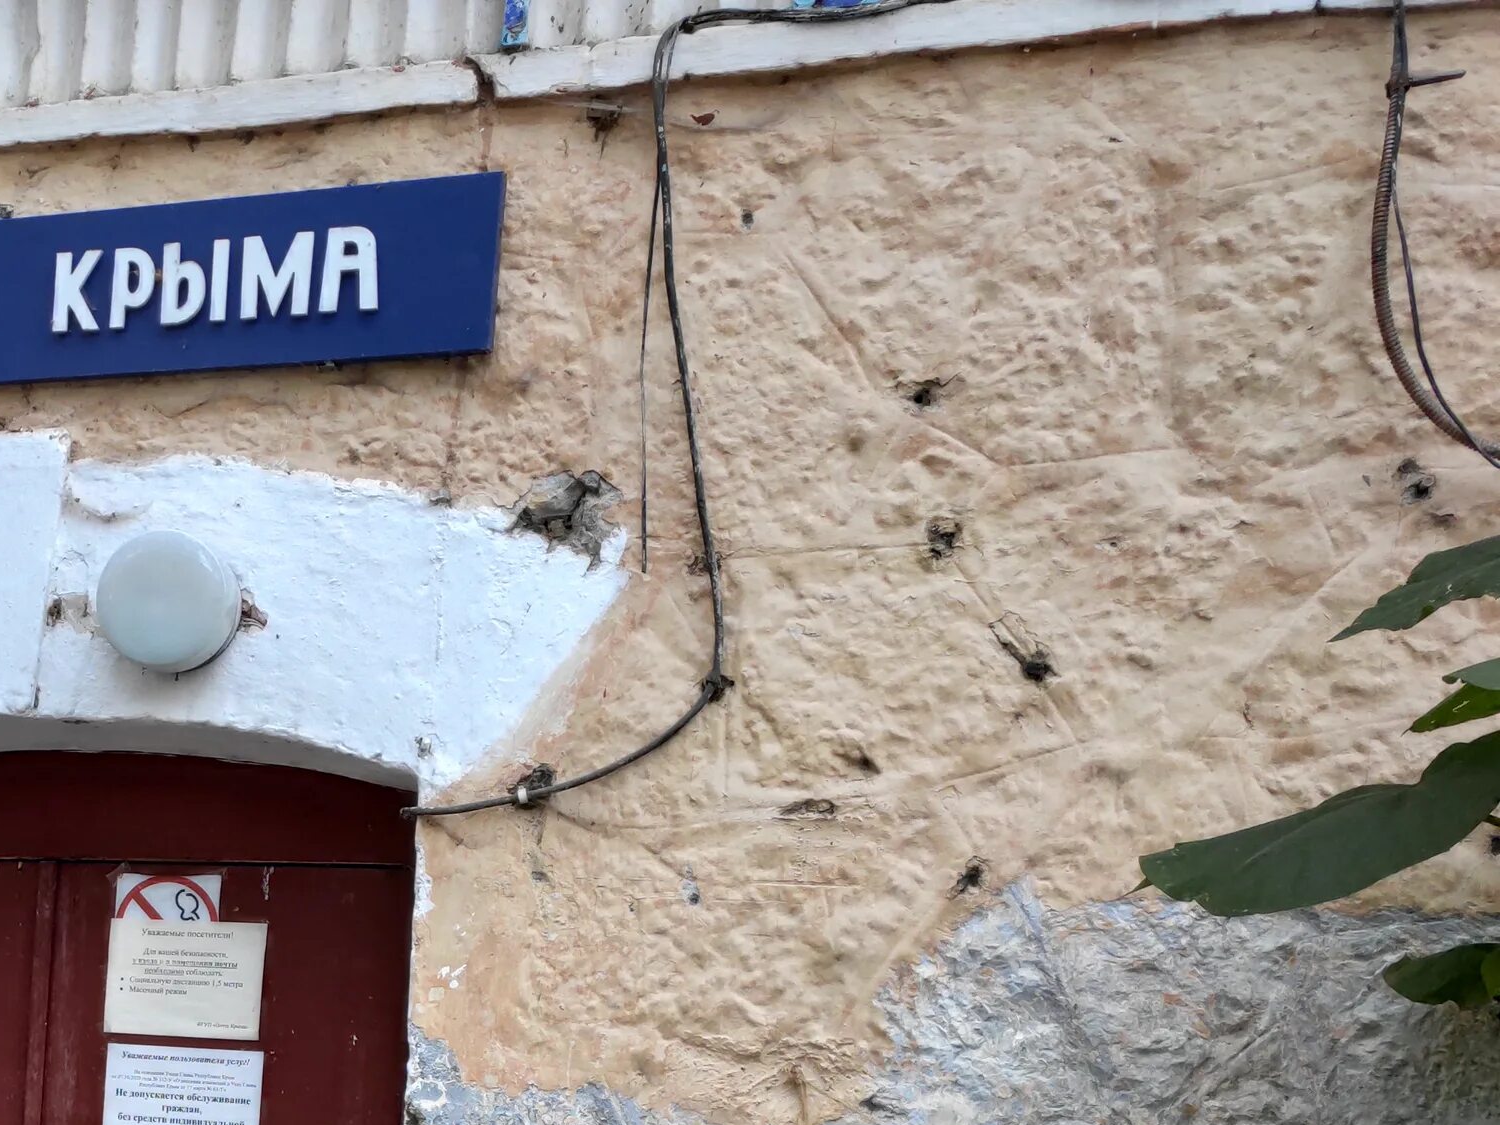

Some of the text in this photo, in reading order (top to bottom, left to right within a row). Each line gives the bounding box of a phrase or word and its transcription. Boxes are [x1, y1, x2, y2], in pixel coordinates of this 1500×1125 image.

[50, 225, 379, 334] КРЫМА
[142, 928, 234, 940] Уважаемые посетители!
[129, 987, 164, 995] Масочный
[122, 1051, 168, 1063] Уважаемые
[170, 1054, 224, 1066] пользователи
[116, 1088, 251, 1107] Не допускается обслуживание
[161, 1104, 202, 1116] граждан,
[117, 1112, 131, 1123] без
[133, 1113, 167, 1125] средств
